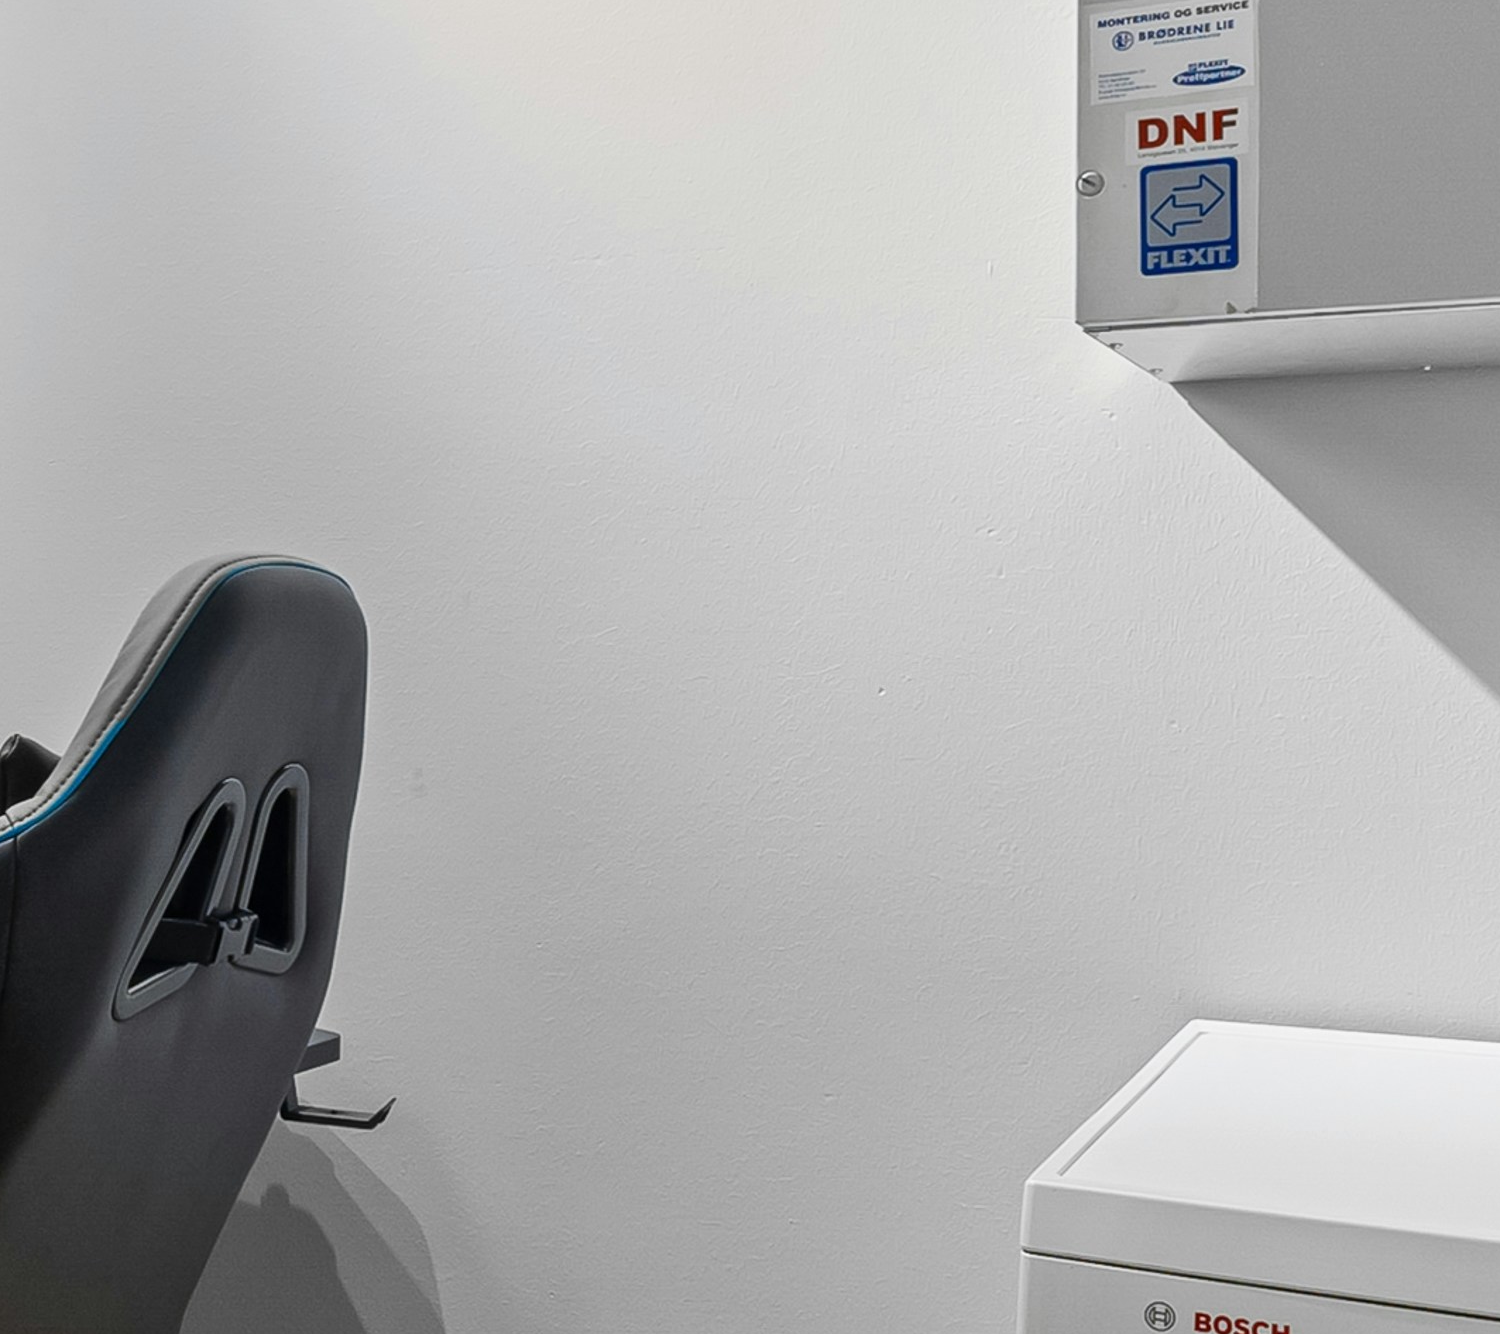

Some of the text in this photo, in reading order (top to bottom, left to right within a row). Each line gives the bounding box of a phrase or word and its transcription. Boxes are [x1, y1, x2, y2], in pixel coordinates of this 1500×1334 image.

[1097, 0, 1250, 29] MONTERING OG SERVICE
[1138, 22, 1212, 42] BRØDRENE
[1216, 19, 1236, 31] LIE
[1137, 107, 1239, 150] DNF
[1146, 244, 1232, 270] FLEXIT
